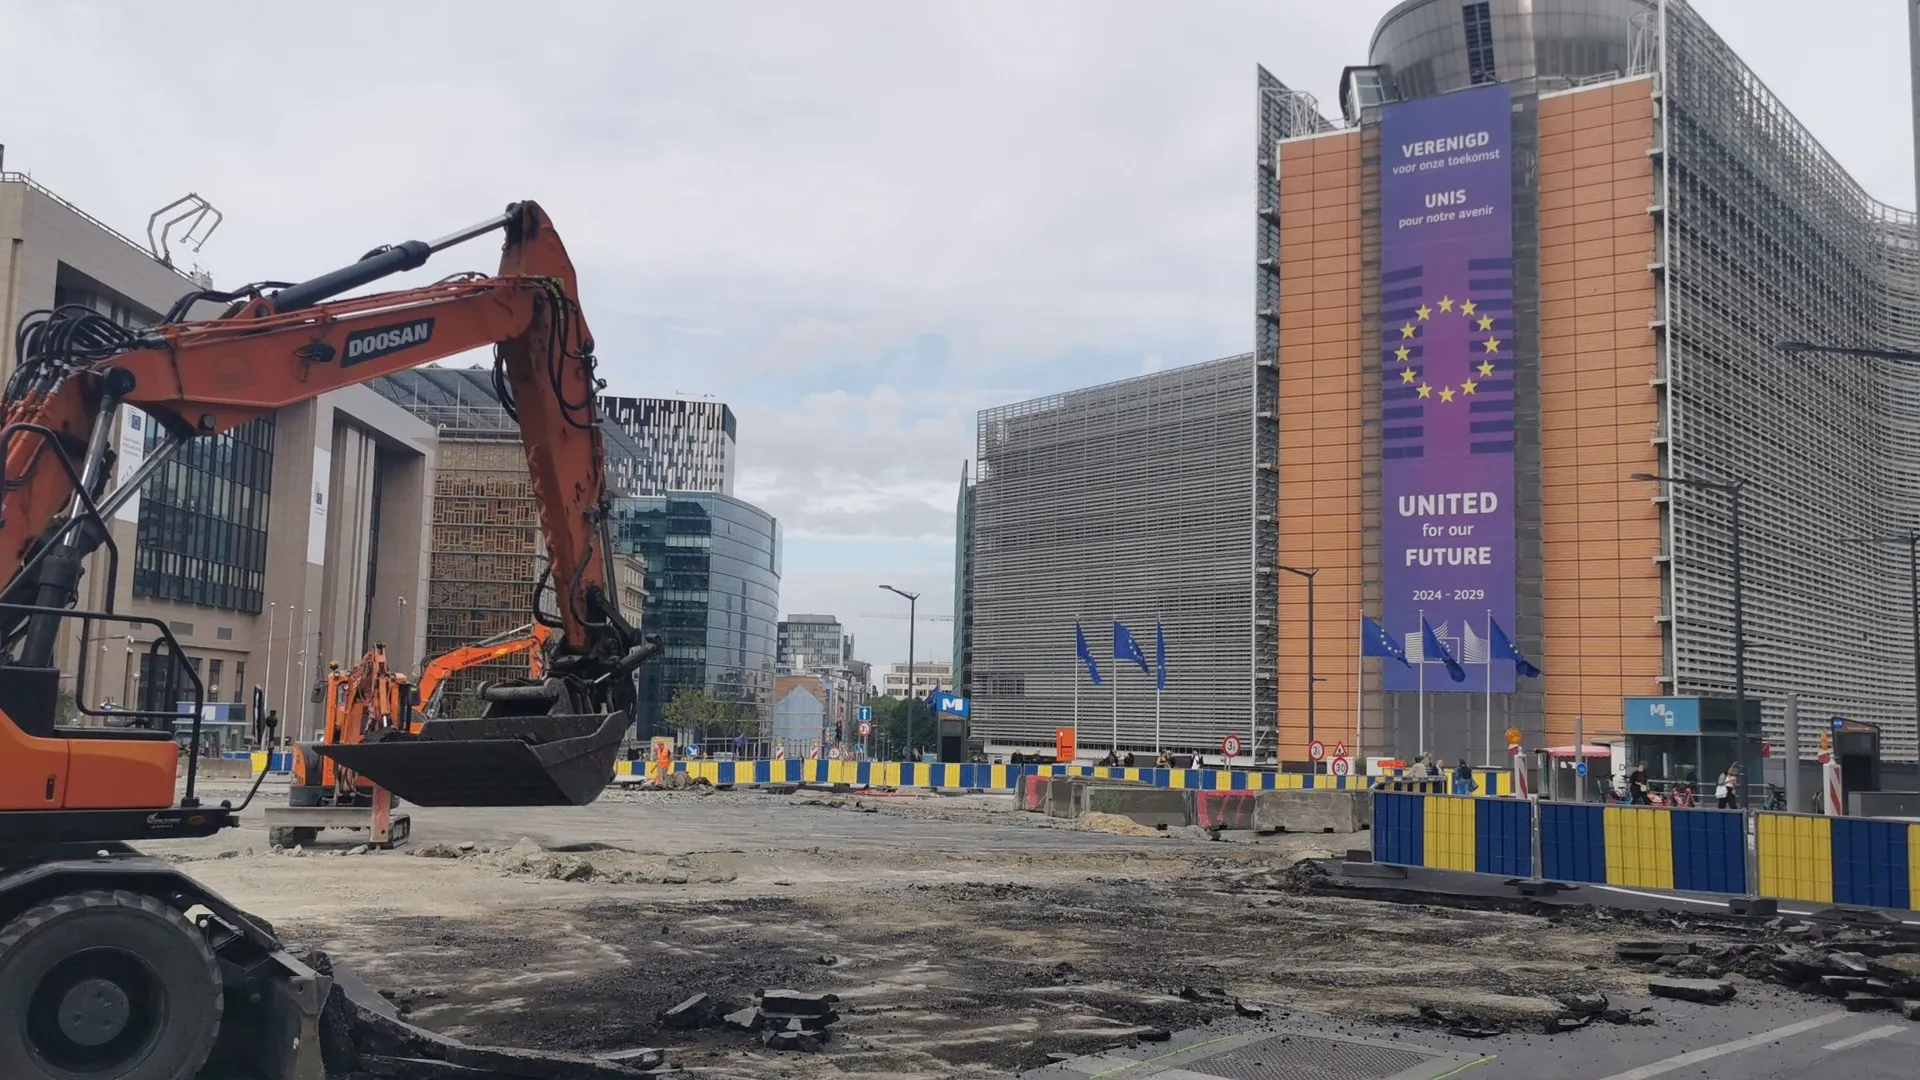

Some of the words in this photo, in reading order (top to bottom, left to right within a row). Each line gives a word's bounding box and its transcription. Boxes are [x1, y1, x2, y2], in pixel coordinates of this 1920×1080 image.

[1401, 131, 1490, 158] VERENIGD
[1393, 163, 1416, 175] voor
[1419, 159, 1445, 171] onze
[1447, 148, 1500, 166] toekomst
[1424, 189, 1467, 208] UNIS
[1398, 215, 1423, 229] pour
[1426, 210, 1456, 224] notre
[1458, 205, 1494, 219] avenir
[348, 322, 428, 357] DOOSAN
[1398, 491, 1498, 517] UNITED
[1422, 523, 1444, 537] for
[1448, 524, 1474, 536] our
[1405, 546, 1492, 567] FUTURE
[1412, 590, 1442, 601] 2024
[1453, 589, 1484, 600] 2029
[1335, 763, 1346, 773] 30
